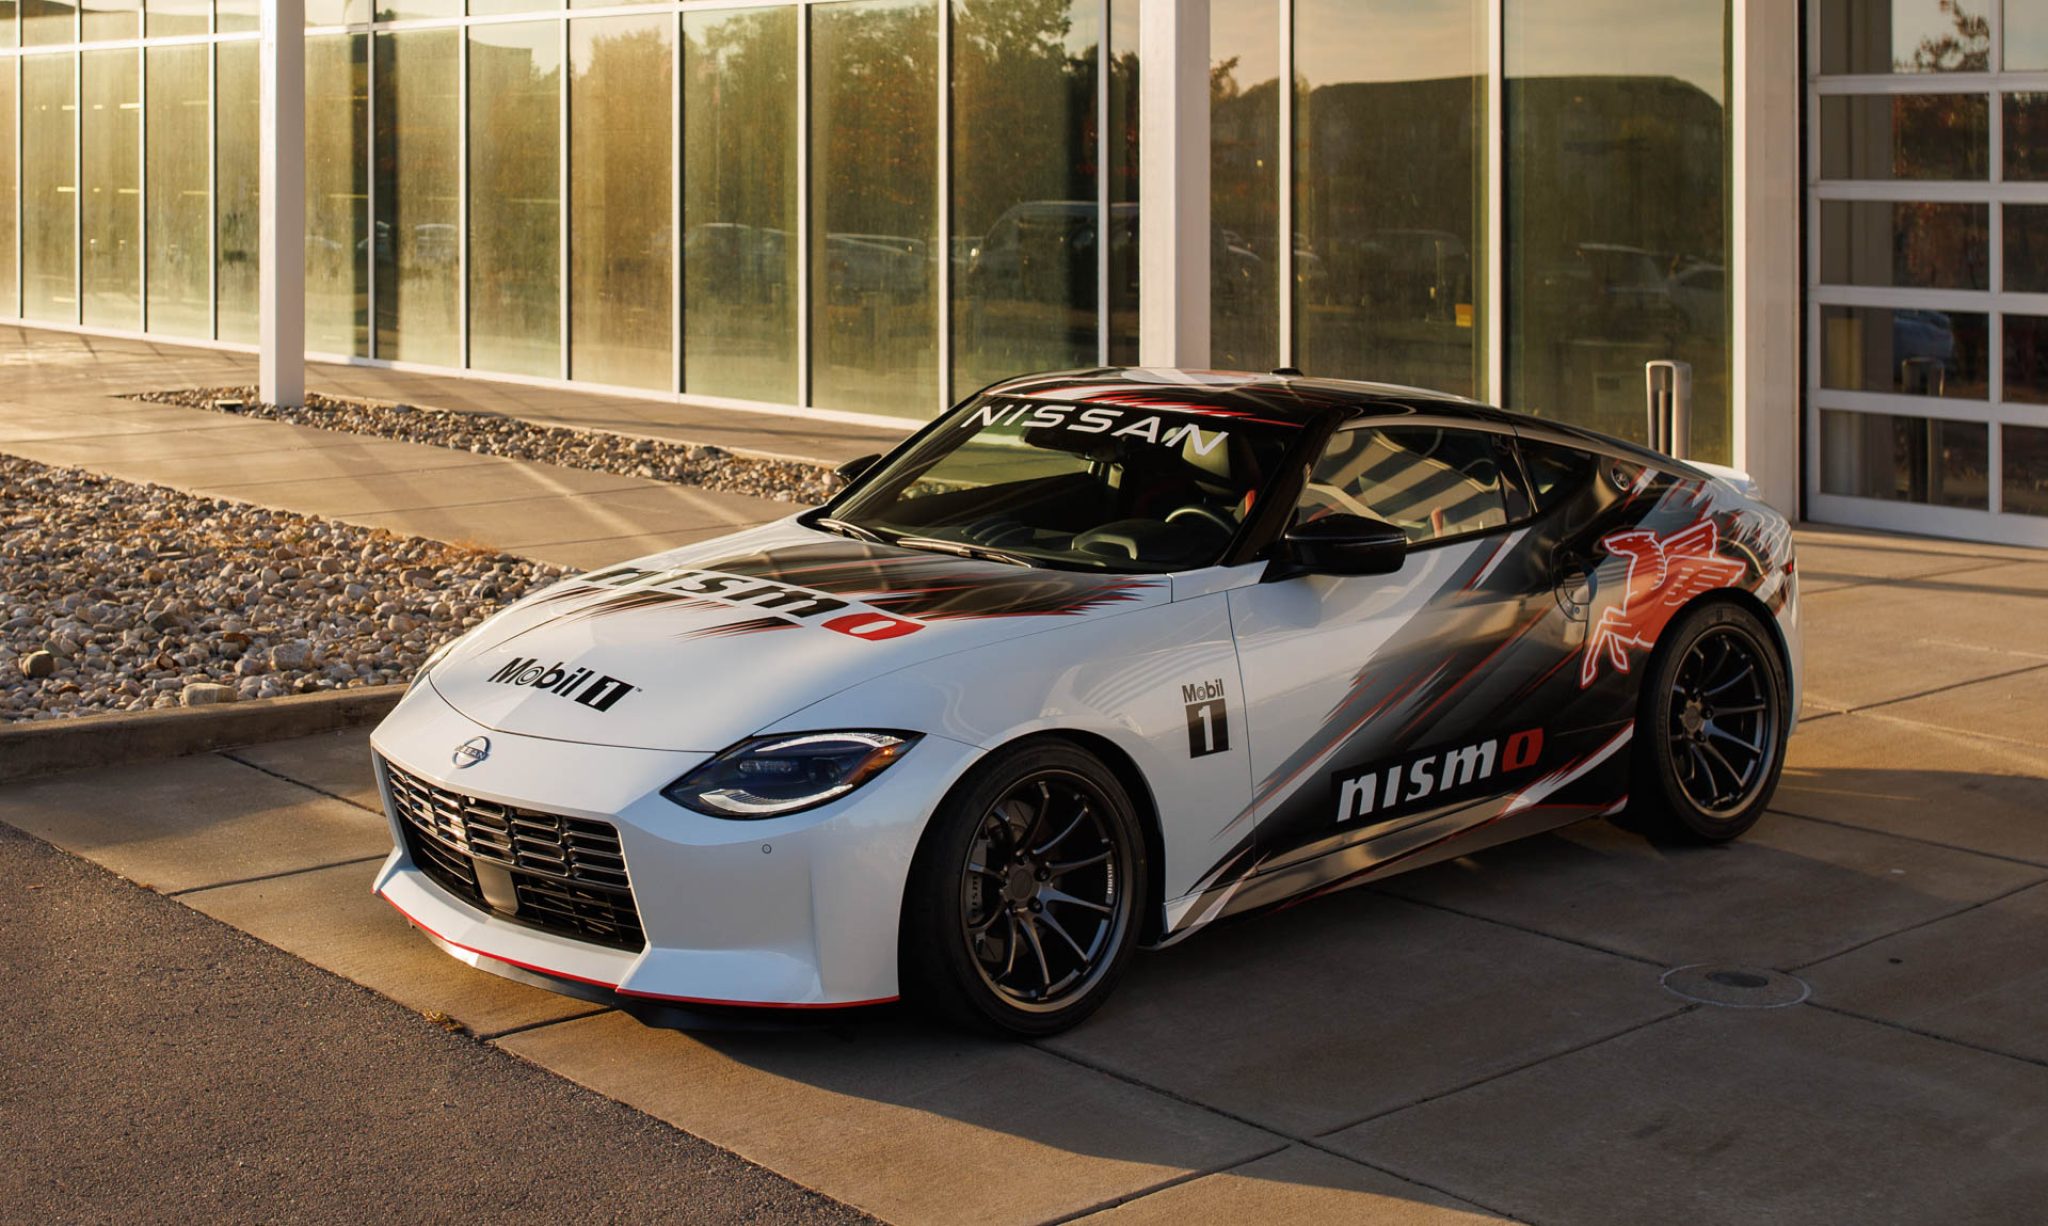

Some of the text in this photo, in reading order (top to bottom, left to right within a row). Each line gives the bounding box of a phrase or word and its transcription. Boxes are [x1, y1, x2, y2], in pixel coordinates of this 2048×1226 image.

[960, 404, 1230, 456] NISSAN
[581, 567, 926, 641] nismo
[487, 657, 596, 697] Mobil
[1182, 678, 1224, 703] Mobil
[1198, 704, 1214, 752] 1
[1335, 727, 1543, 822] nismo
